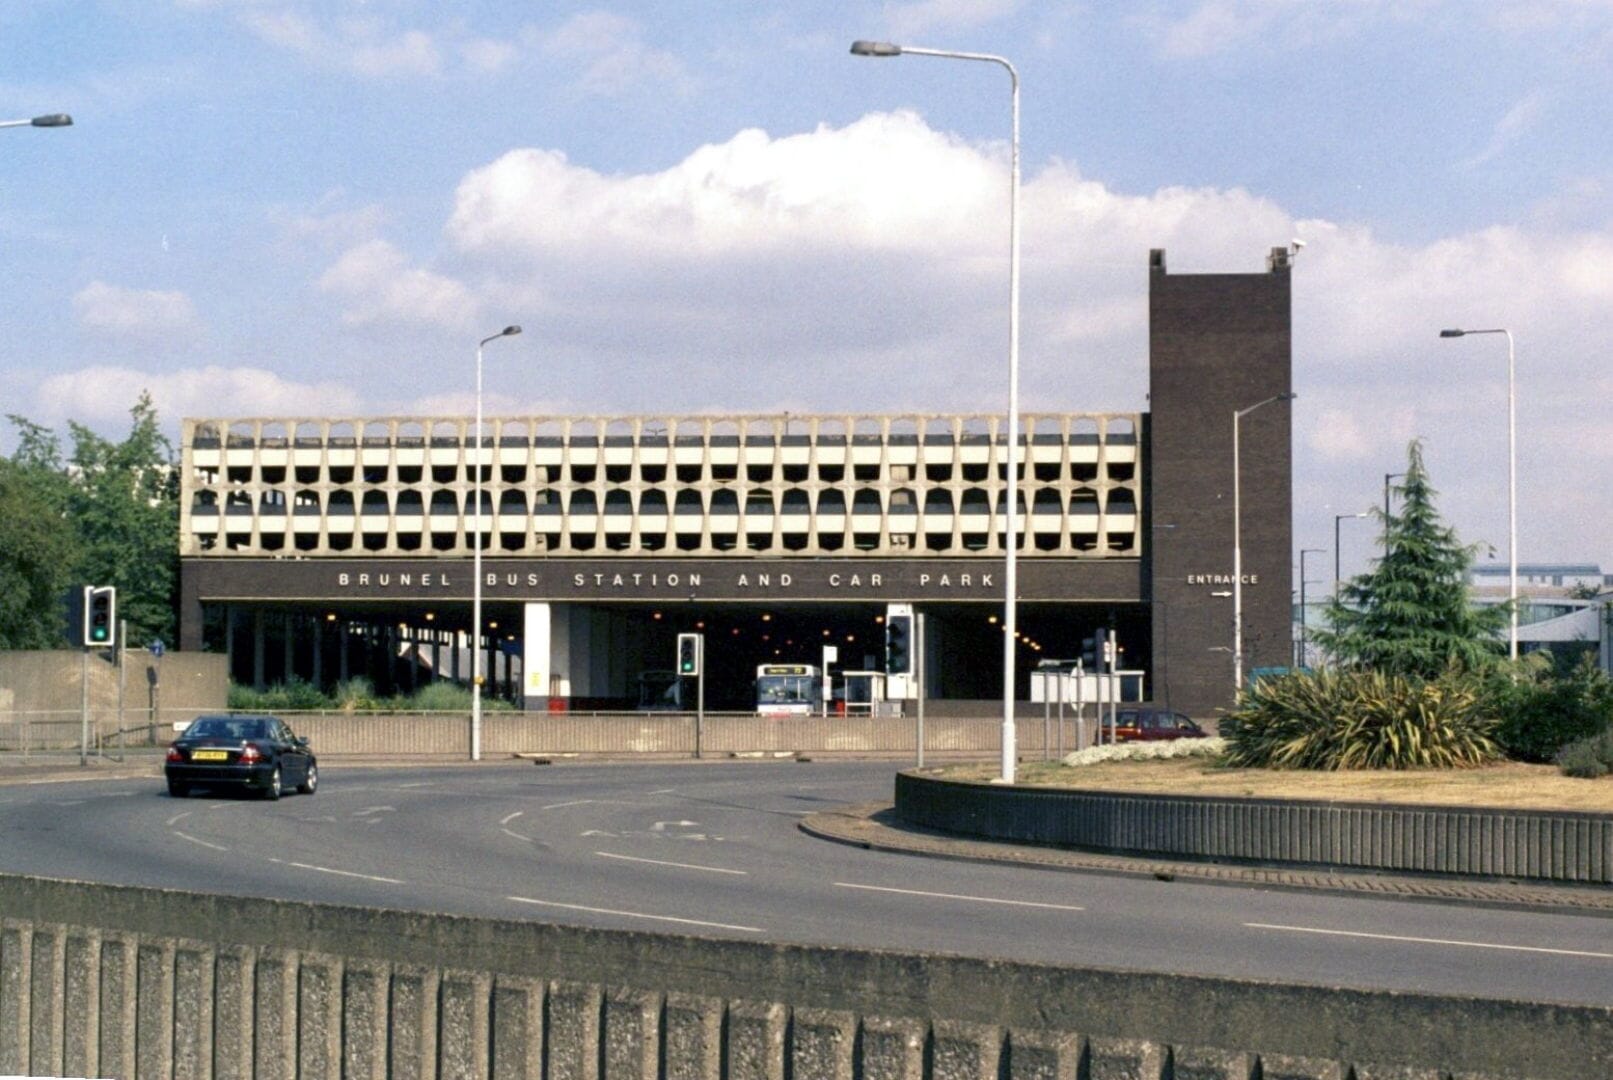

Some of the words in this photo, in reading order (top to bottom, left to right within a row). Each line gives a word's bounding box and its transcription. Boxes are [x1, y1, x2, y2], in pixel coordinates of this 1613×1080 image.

[338, 573, 450, 586] BRUNEL
[487, 573, 538, 586] BUS
[574, 573, 701, 586] STATION
[738, 573, 792, 586] AND
[829, 573, 882, 586] CAR
[920, 573, 993, 586] PARK
